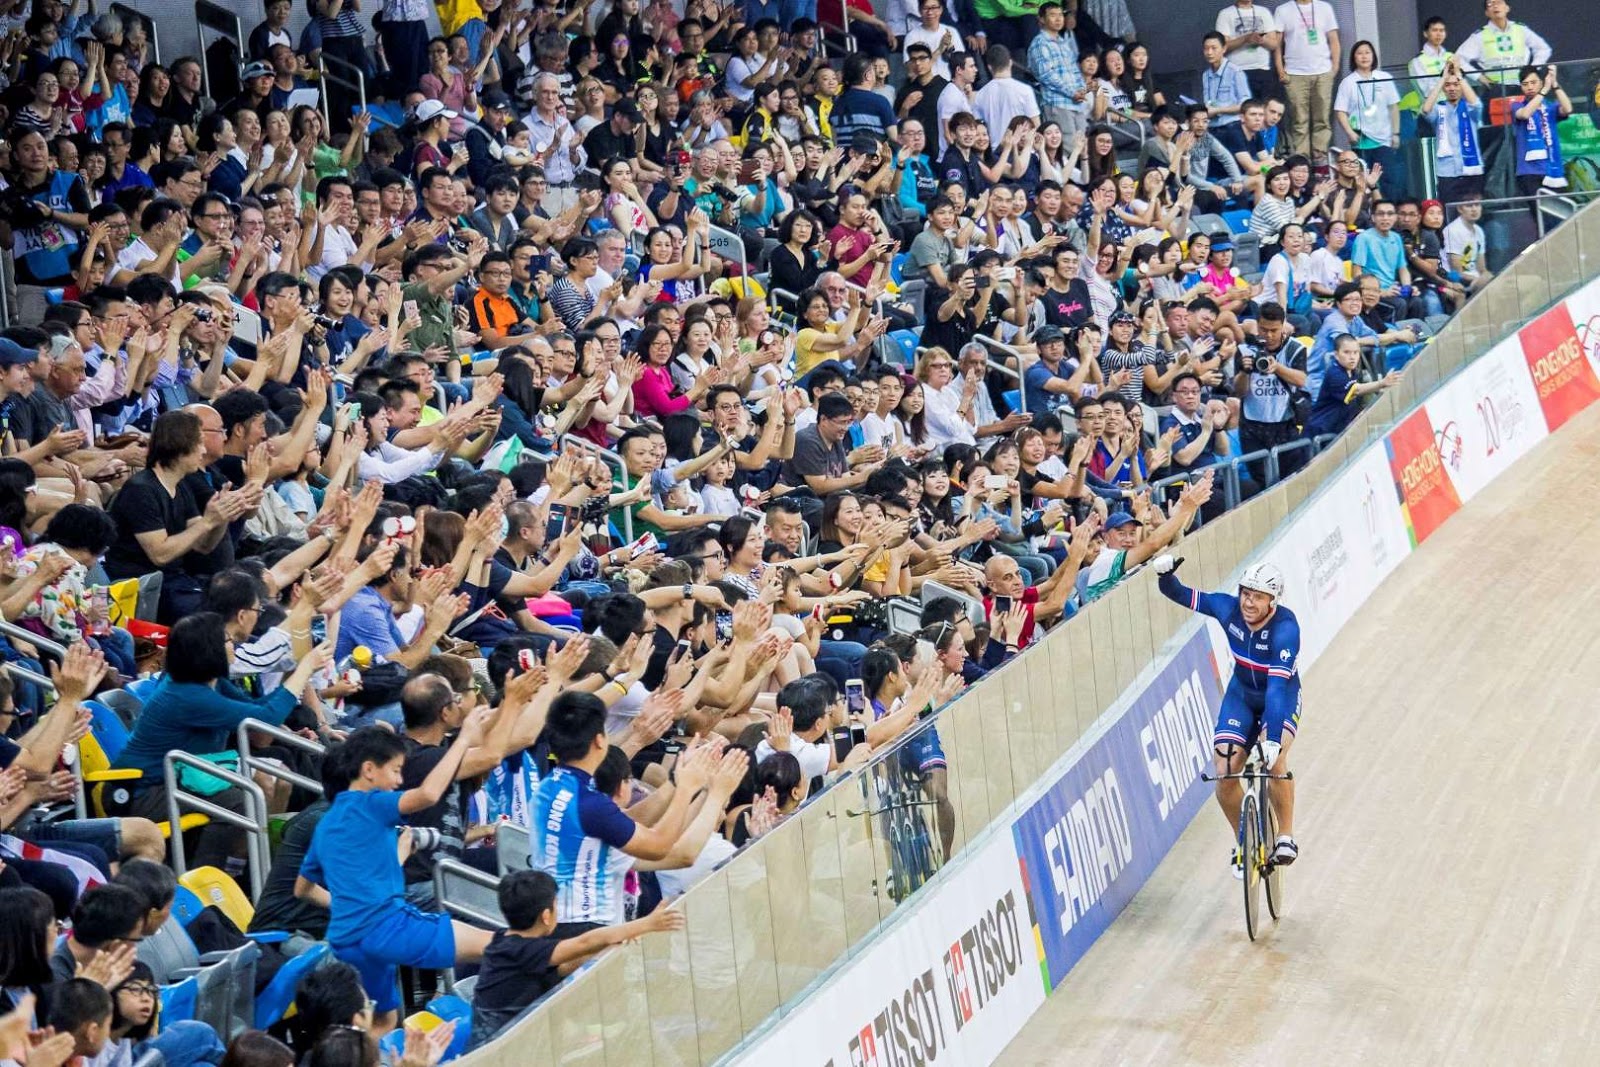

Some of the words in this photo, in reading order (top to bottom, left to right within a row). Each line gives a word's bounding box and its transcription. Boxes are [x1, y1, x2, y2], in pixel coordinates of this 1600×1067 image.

[1058, 300, 1083, 316] Rapha
[1140, 669, 1214, 821] SHIMANO
[546, 789, 574, 832] HONG
[1044, 766, 1132, 936] SHIMANO
[961, 889, 1023, 1010] TISSOT
[873, 967, 946, 1067] TISSOT
